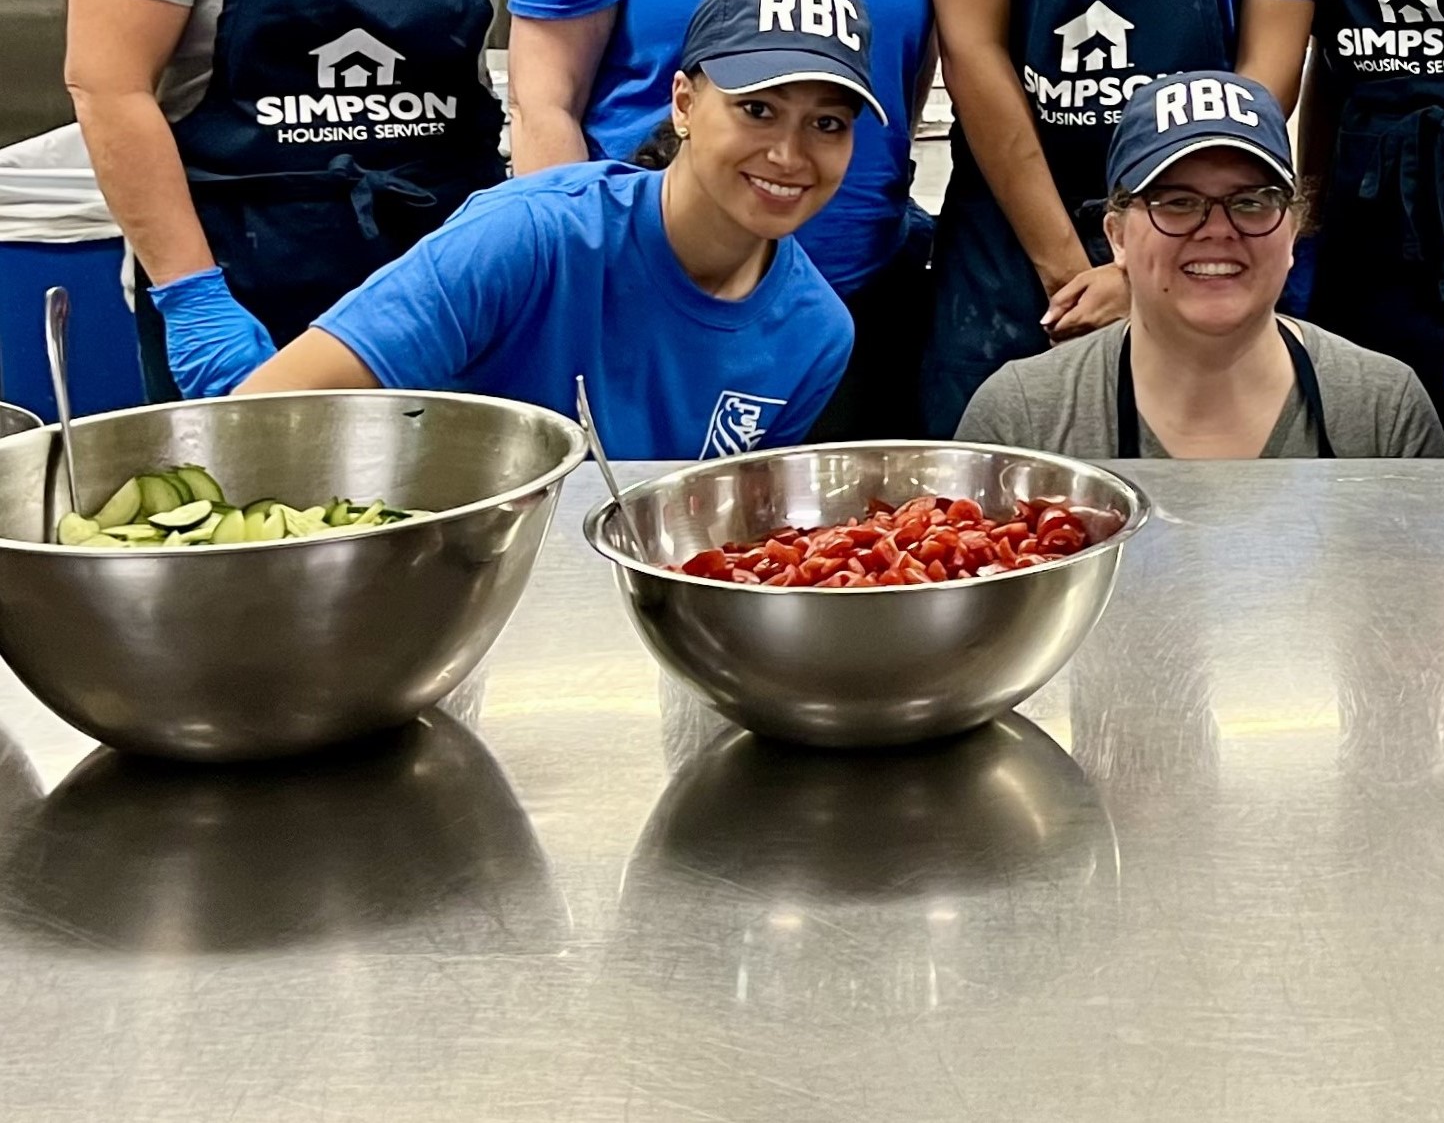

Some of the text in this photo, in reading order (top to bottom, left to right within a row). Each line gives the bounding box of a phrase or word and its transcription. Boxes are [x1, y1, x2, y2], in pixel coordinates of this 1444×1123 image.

[1354, 58, 1420, 74] HOUSING
[1024, 64, 1183, 108] SIMPSO
[256, 92, 457, 125] SIMPSON
[1156, 78, 1259, 134] RBC
[277, 122, 445, 143] HOUSING SERVICES
